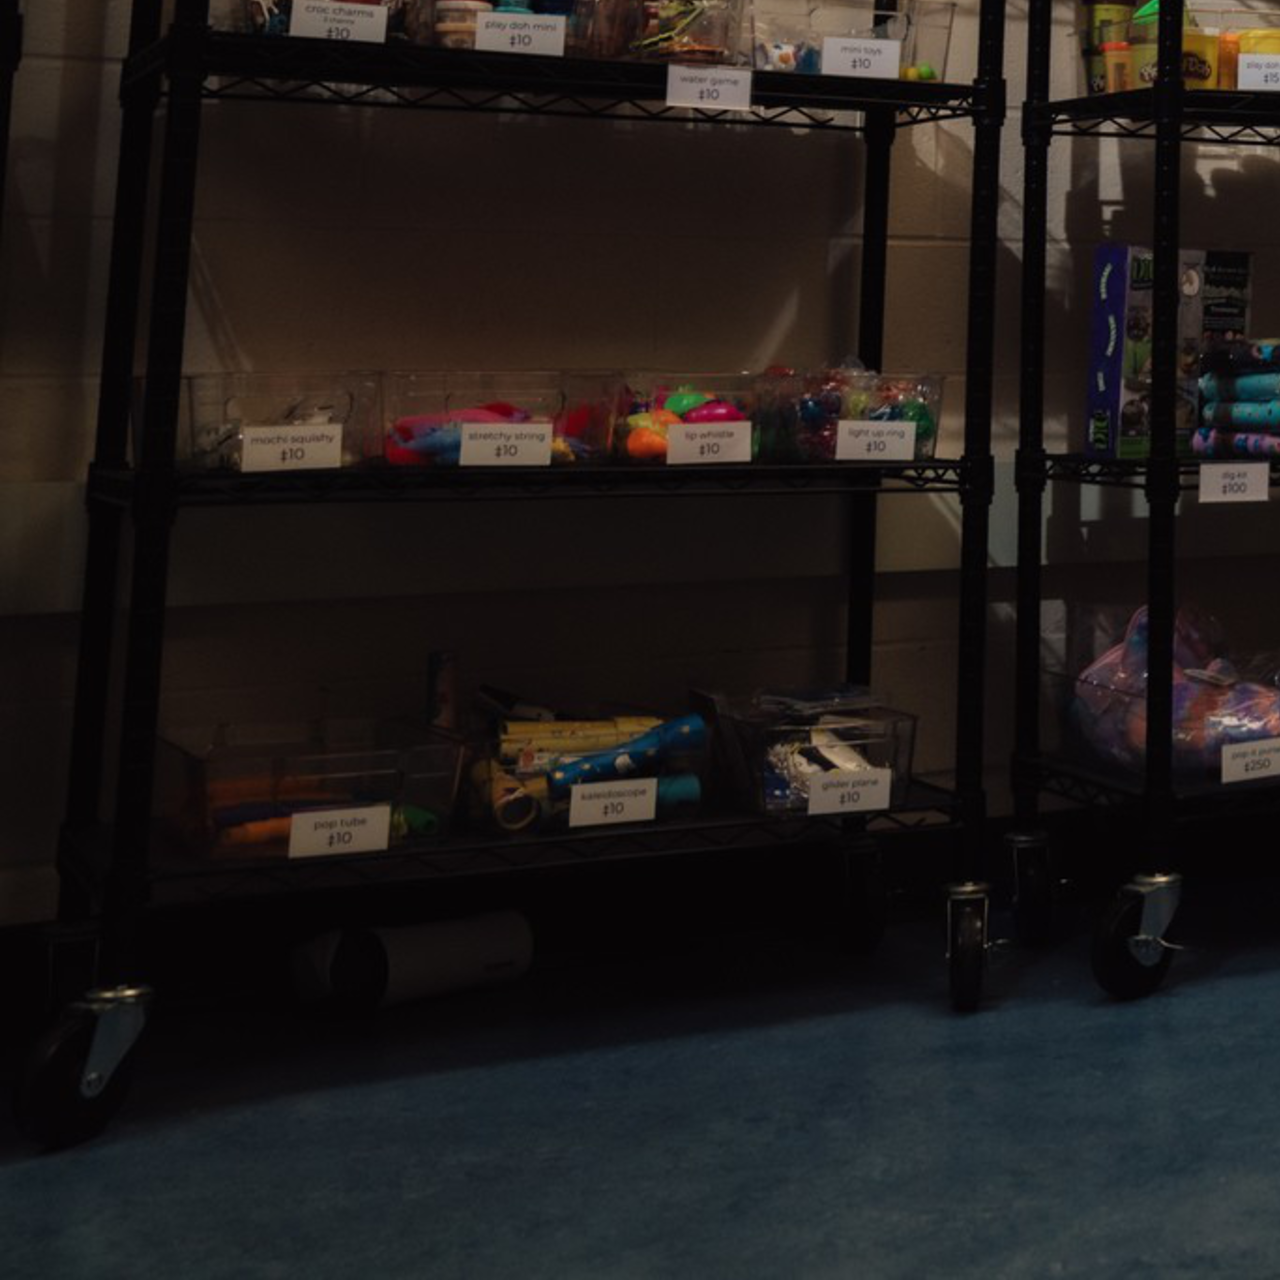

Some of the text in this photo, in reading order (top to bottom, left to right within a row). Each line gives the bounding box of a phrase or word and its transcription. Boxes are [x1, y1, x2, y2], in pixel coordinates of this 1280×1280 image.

[305, 4, 374, 19] croc charms
[485, 20, 558, 32] play doh mini
[841, 46, 882, 57] mini toys
[1246, 61, 1280, 72] play doh
[680, 75, 708, 83] water
[468, 431, 546, 443] stretchy string
[700, 430, 736, 440] whistle
[849, 427, 906, 439] light up ring
[852, 778, 880, 789] plane
[581, 788, 648, 802] kaleidoscope
[315, 817, 367, 832] pop tube
